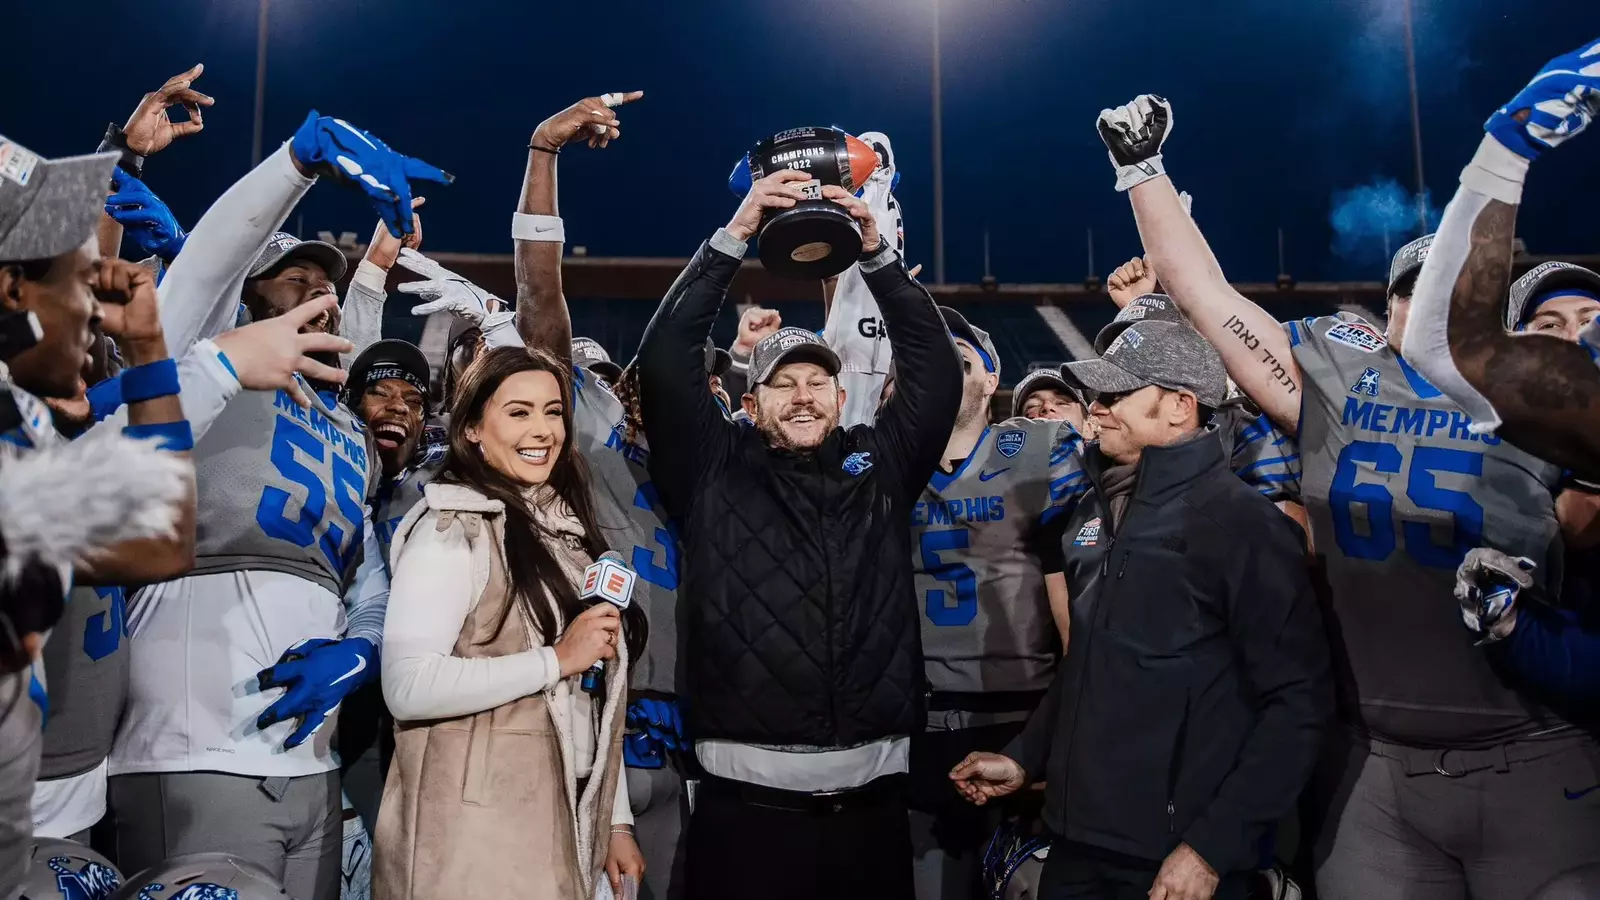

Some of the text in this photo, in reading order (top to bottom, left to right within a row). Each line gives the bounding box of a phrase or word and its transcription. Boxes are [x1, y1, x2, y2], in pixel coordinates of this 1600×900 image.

[771, 147, 825, 164] CHAMPIONS
[787, 159, 811, 171] 2022
[762, 330, 820, 351] CHAMPIONS
[1331, 328, 1378, 349] RESPONDER
[1335, 323, 1386, 346] FIRST
[1223, 315, 1297, 394] תמיד נאמן
[366, 368, 402, 383] NIKE
[273, 389, 366, 472] MEMPHIS
[1341, 396, 1502, 446] MEMPH
[256, 413, 365, 580] 55
[1329, 440, 1483, 571] 65
[1078, 525, 1100, 536] FIRST
[920, 529, 978, 626] 5
